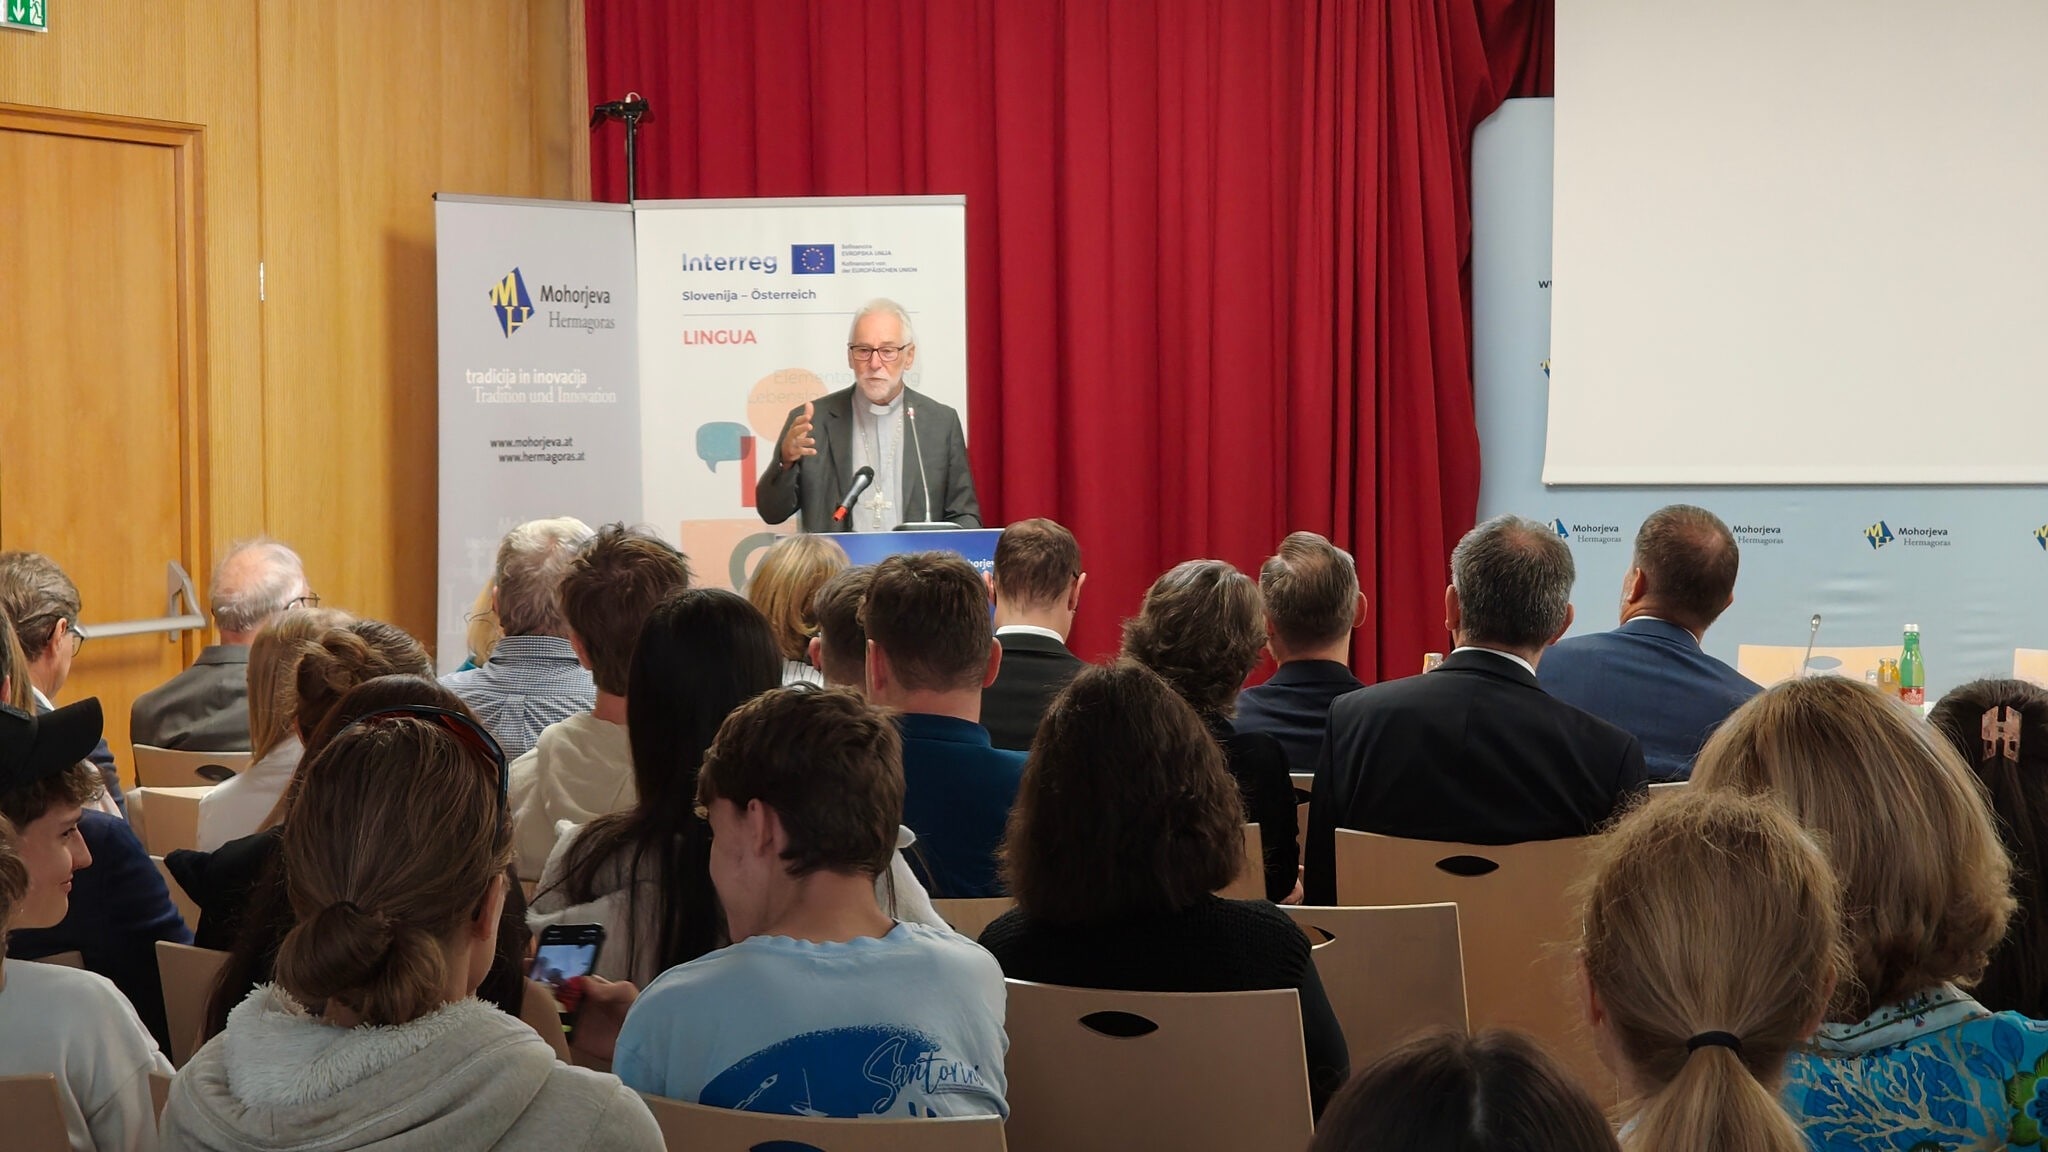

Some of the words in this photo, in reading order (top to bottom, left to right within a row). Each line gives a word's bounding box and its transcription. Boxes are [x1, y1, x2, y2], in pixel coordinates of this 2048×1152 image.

[682, 253, 777, 274] Interreg
[540, 285, 610, 308] Mohorjeva
[682, 290, 738, 303] Slovenija
[751, 287, 817, 301] Österreich
[549, 311, 615, 334] Hermagoras
[683, 329, 758, 345] LINGUA
[465, 368, 517, 388] tradicija
[519, 368, 530, 384] in
[533, 368, 587, 389] inovacija
[472, 386, 526, 403] Tradition
[529, 386, 554, 403] und
[558, 386, 617, 403] Innovation
[490, 436, 573, 450] www.mohorjeva.at
[498, 451, 585, 464] www.hermagoras.at
[1572, 524, 1619, 534] Mohorjeva
[1732, 525, 1781, 535] Mohorjeva
[1898, 527, 1948, 538] Mohorjeva
[1577, 534, 1621, 544] Hermagoras
[1738, 536, 1784, 545] Hermagoras
[1903, 538, 1951, 548] Hermagoras
[863, 1036, 984, 1115] Santorini
